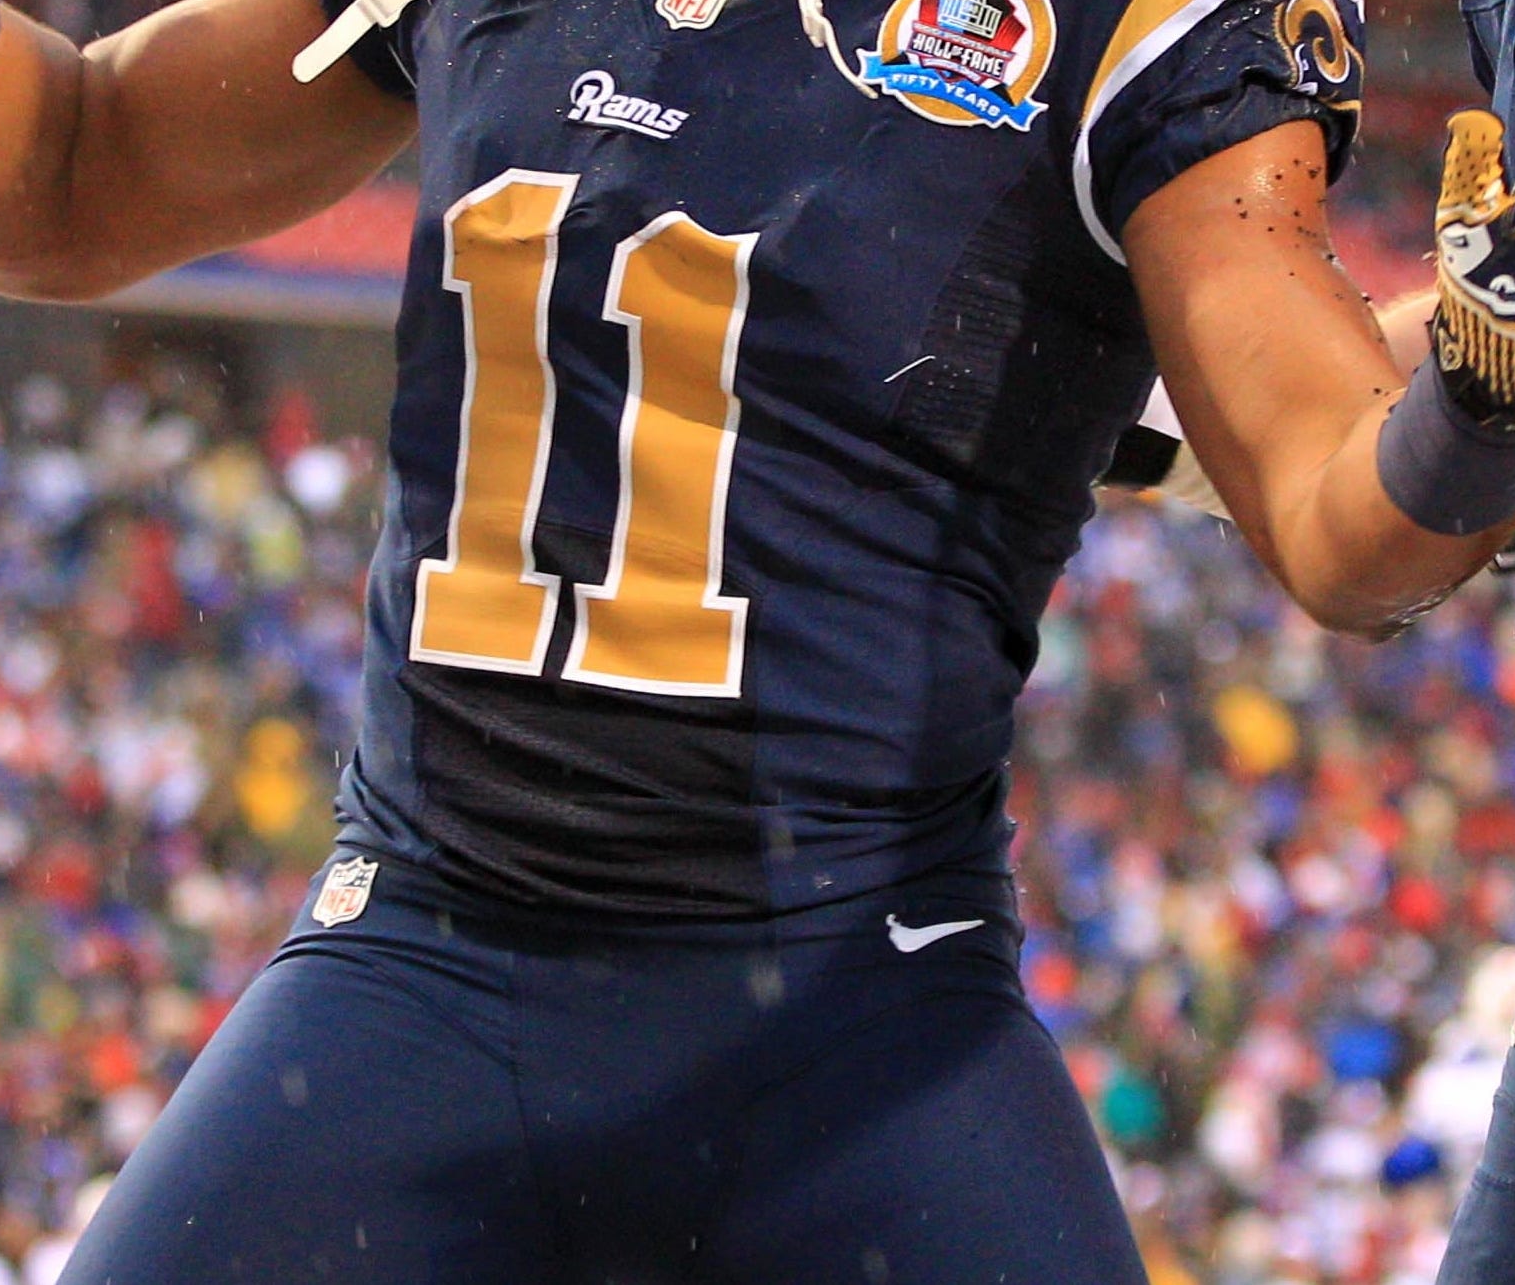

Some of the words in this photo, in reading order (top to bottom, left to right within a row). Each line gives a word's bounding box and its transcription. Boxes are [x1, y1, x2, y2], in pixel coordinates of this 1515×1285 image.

[912, 33, 953, 60] HALL
[960, 47, 1005, 77] FAME
[567, 69, 691, 140] Rams
[891, 73, 939, 90] FIFTY
[944, 84, 1001, 117] YEARS
[408, 167, 762, 699] 11
